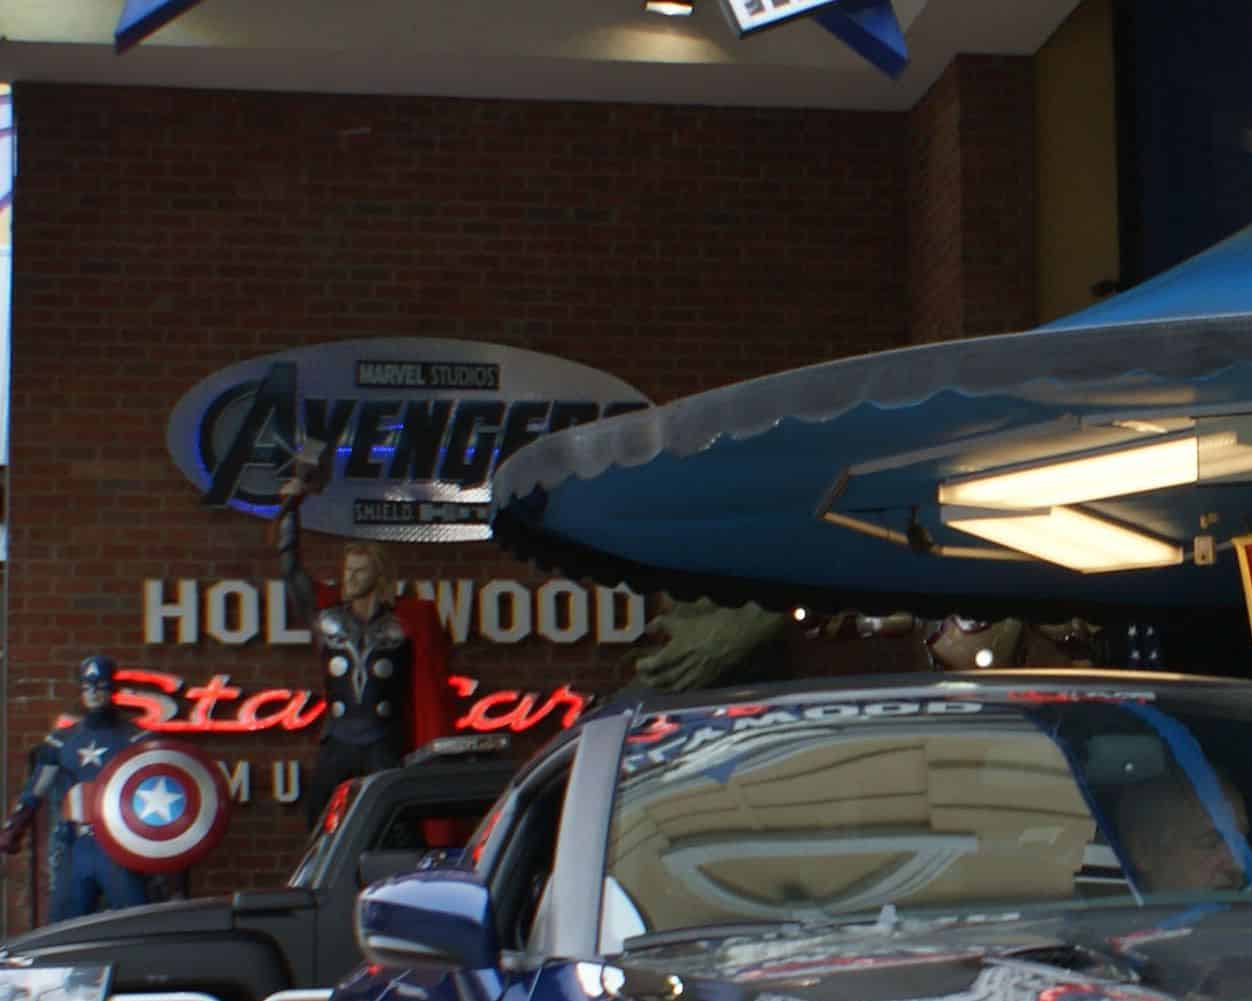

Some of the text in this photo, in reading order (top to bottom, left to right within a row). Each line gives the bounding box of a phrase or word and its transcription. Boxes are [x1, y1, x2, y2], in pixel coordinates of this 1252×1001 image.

[359, 363, 496, 388] MARVEL STUDIOS
[143, 578, 646, 645] HOLWOOD
[56, 667, 327, 733] Sta
